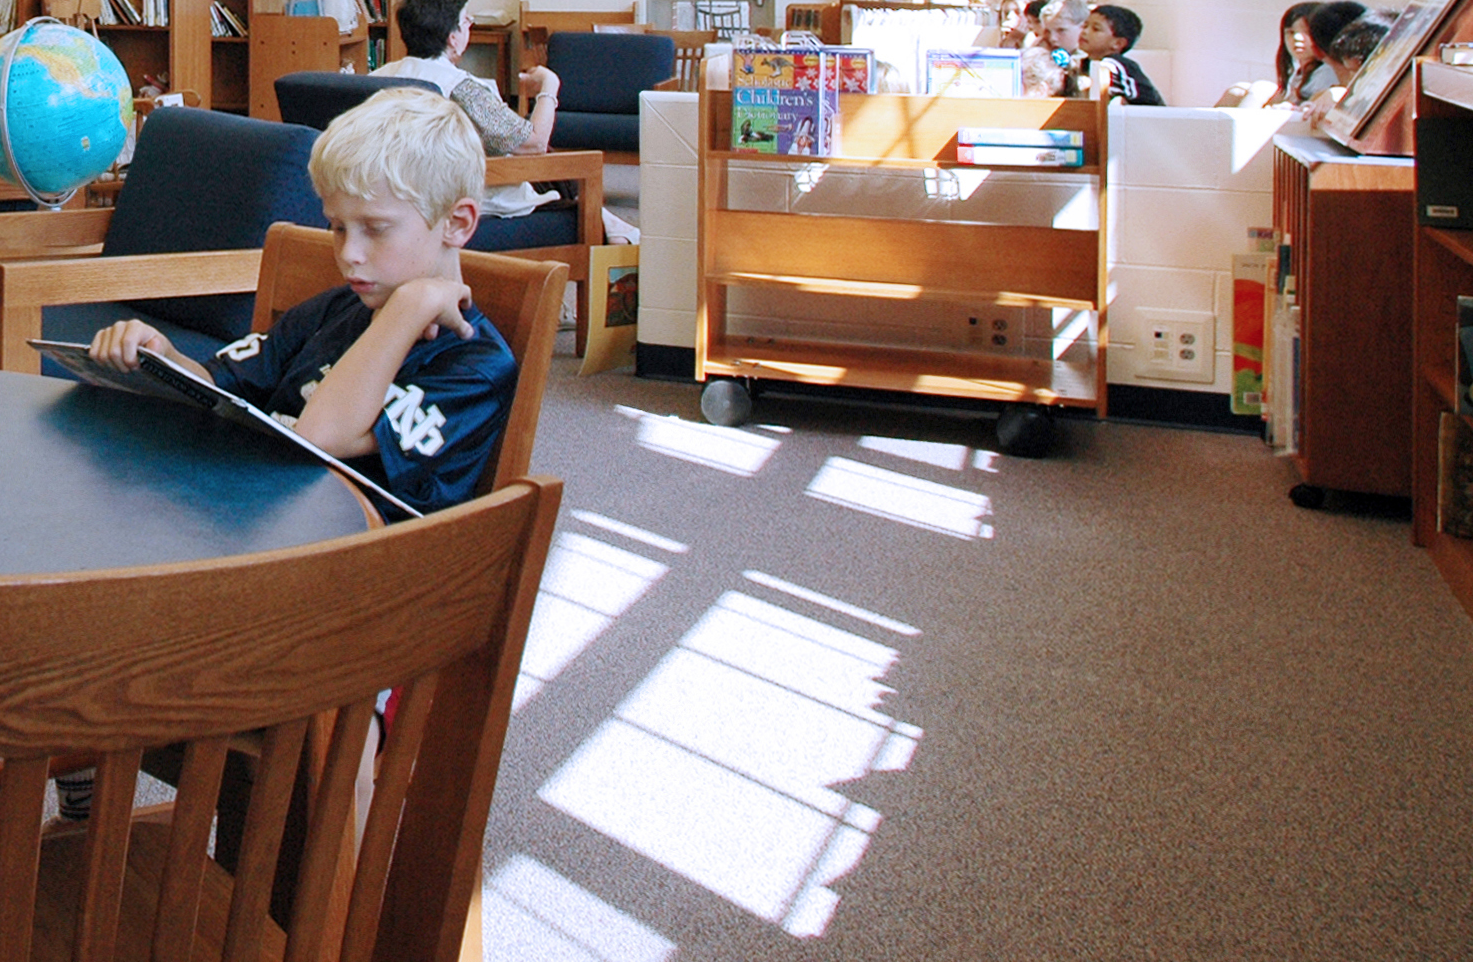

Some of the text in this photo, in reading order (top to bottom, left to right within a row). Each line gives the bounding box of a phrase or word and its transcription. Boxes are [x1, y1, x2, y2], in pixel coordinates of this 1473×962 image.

[737, 75, 793, 88] Scholastic
[736, 89, 814, 107] Children's
[736, 107, 799, 121] Dictionary
